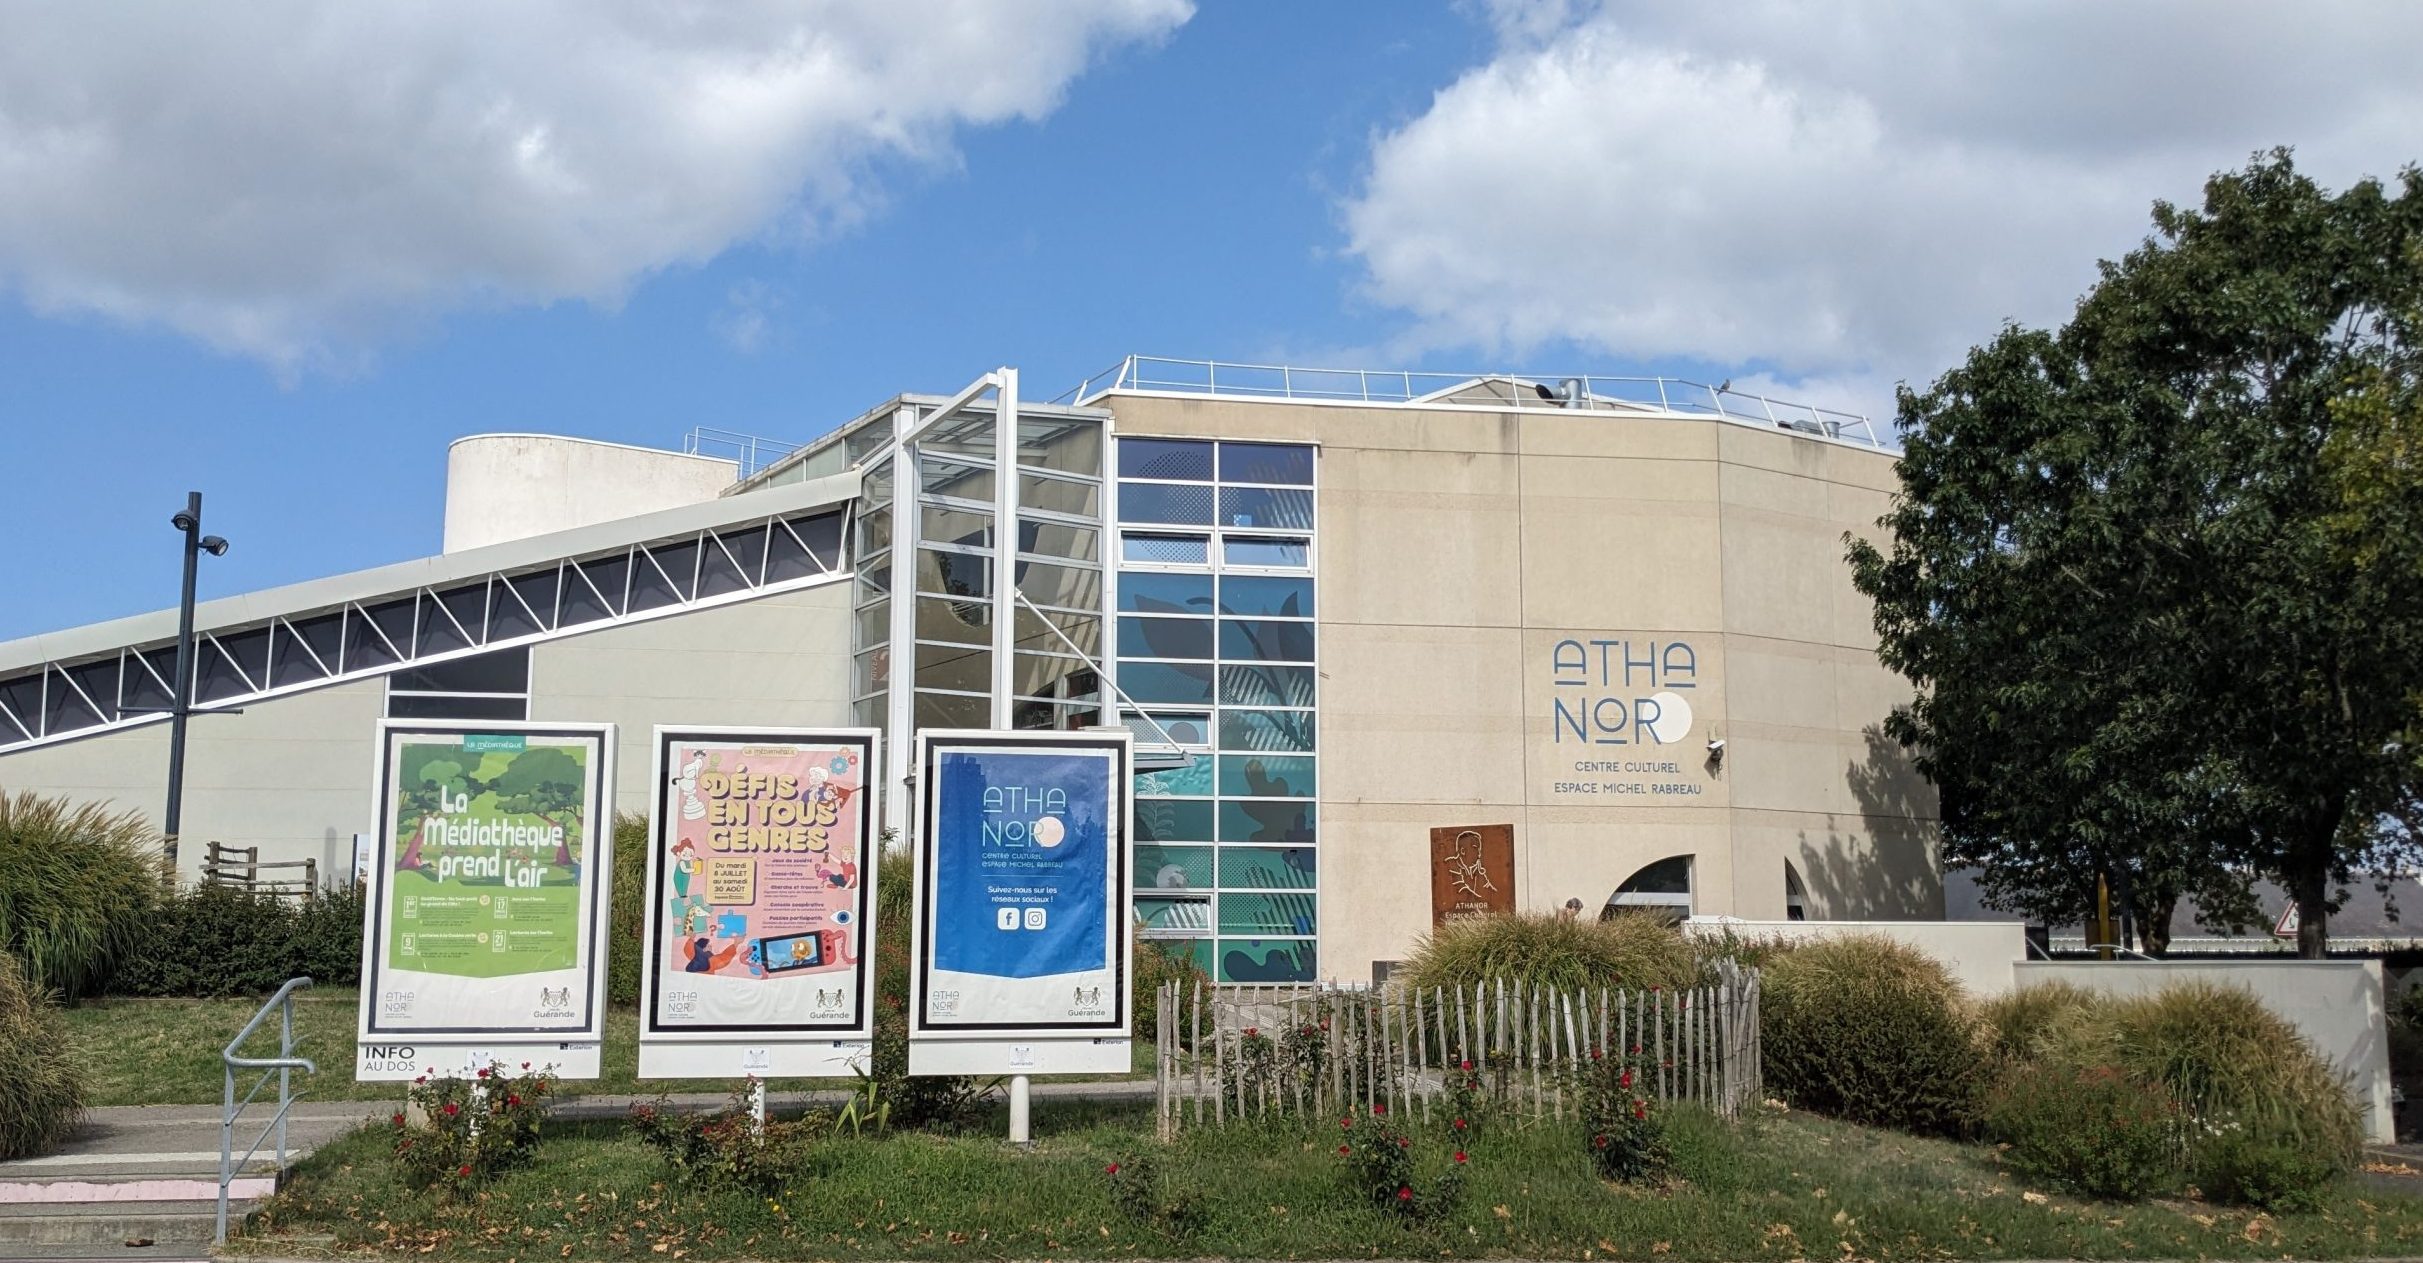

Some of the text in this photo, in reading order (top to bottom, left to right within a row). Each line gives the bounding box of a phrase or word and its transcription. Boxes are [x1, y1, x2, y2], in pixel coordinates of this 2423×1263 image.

[1554, 639, 1696, 688] ATHA
[1554, 696, 1662, 745] NOR
[1575, 761, 1681, 774] CENTRE CULTUREL
[700, 763, 798, 800] DÉFIS
[1554, 782, 1702, 795] ESPACE MICHEL RABREAU
[441, 784, 468, 814] La
[983, 786, 1066, 814] ATHA
[707, 800, 838, 827] EN TOUS
[423, 817, 563, 854] Médiathèque
[706, 825, 829, 853] GENRES
[438, 848, 500, 884] prend
[987, 885, 1032, 894] Suivez-nous
[1046, 886, 1058, 894] les
[385, 991, 415, 1001] ATHA
[669, 991, 698, 1001] ATHA
[932, 990, 960, 1000] ATHA
[533, 1009, 575, 1019] Guérande
[809, 1011, 850, 1019] Guérande
[1068, 1008, 1106, 1017] Guérande
[365, 1046, 415, 1059] INFO
[364, 1060, 416, 1072] AU DOS
